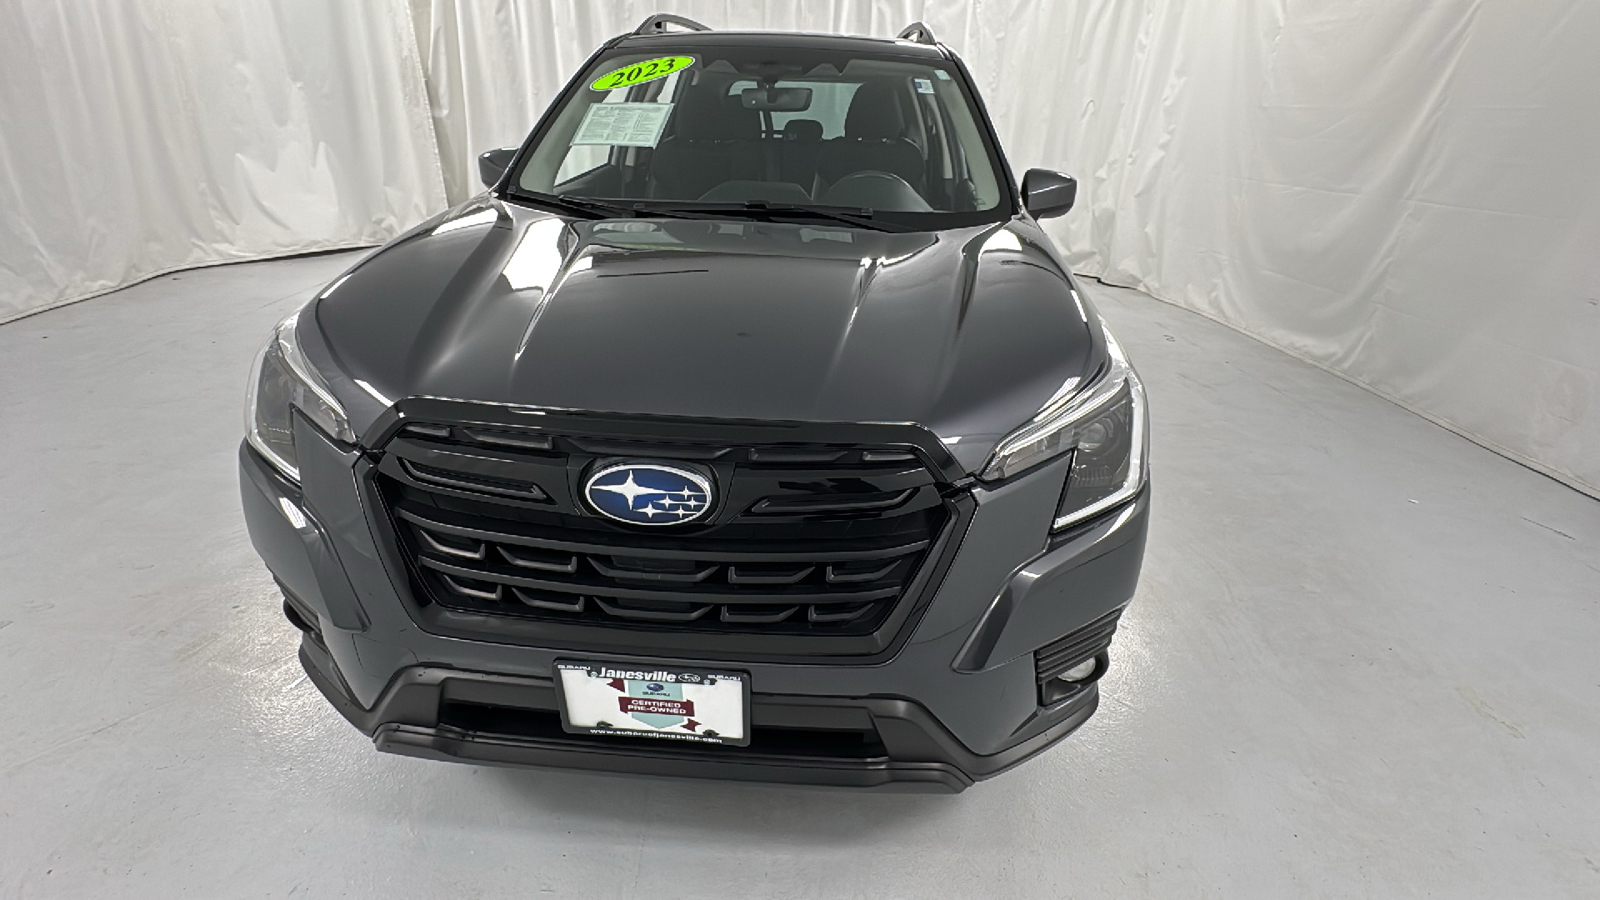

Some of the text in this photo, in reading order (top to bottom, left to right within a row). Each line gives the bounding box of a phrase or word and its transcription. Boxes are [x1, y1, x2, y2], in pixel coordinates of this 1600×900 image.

[609, 58, 676, 88] 2023
[598, 666, 677, 683] Janesville
[707, 674, 741, 682] SUBARU
[627, 704, 686, 714] PRE-OWNED
[631, 699, 681, 708] CERTIFIED
[590, 729, 723, 743] www.subaruofjanesville.com
